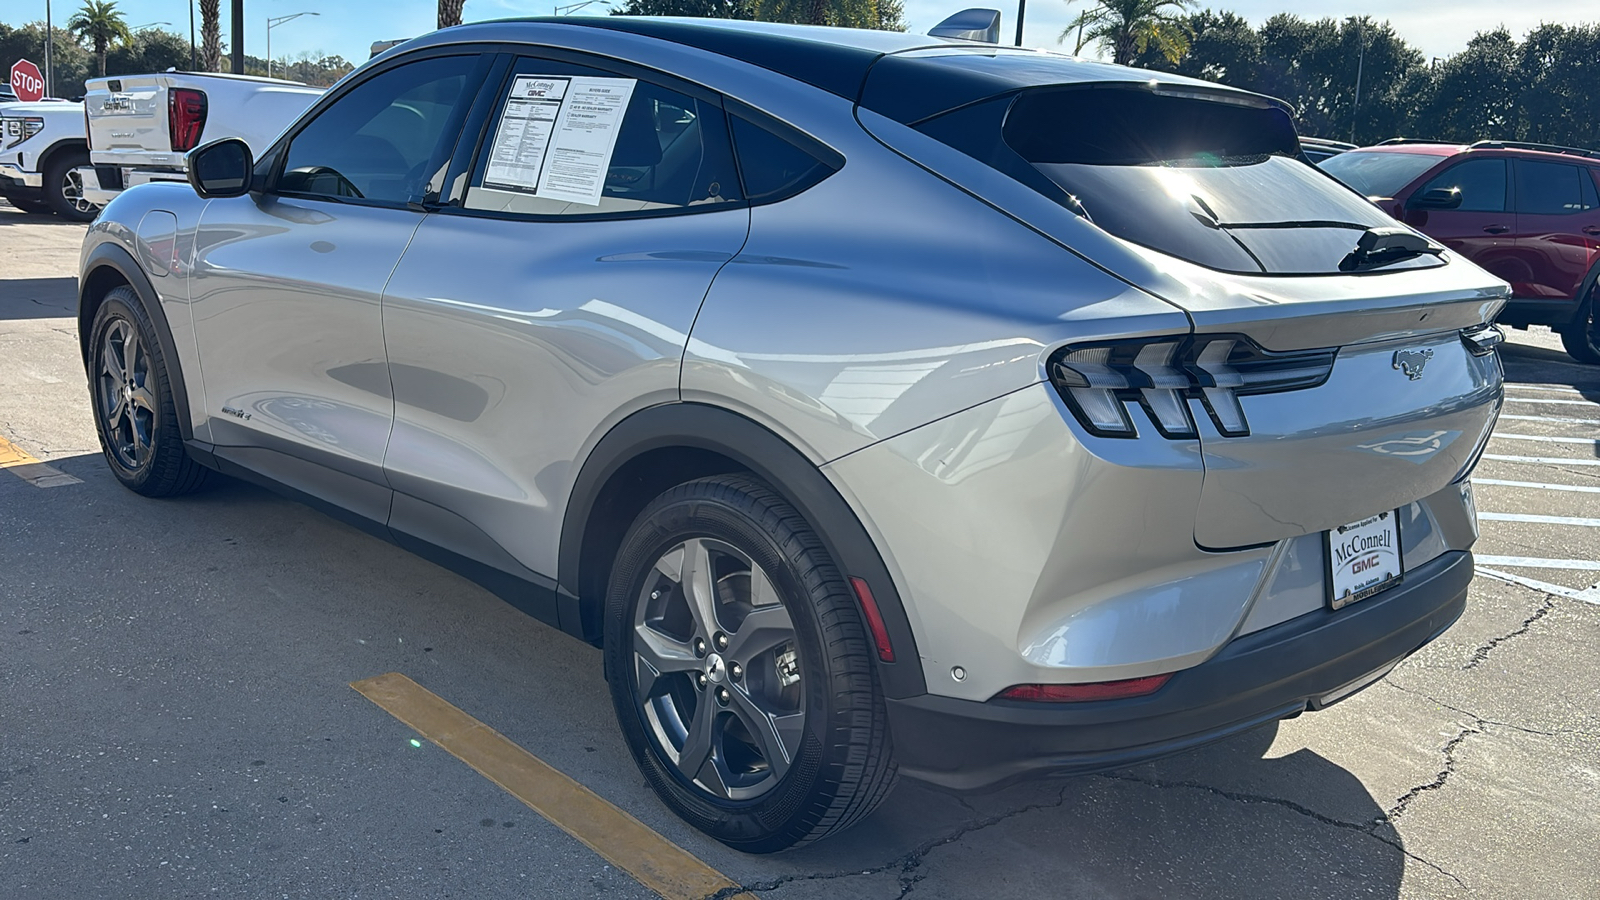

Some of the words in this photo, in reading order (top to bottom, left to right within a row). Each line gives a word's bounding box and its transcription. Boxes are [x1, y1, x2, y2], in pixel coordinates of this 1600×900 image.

[12, 70, 42, 95] STOP
[525, 81, 555, 90] McConnell
[1360, 518, 1372, 527] Applied
[1335, 529, 1391, 566] McConnell
[1352, 554, 1380, 575] GMC
